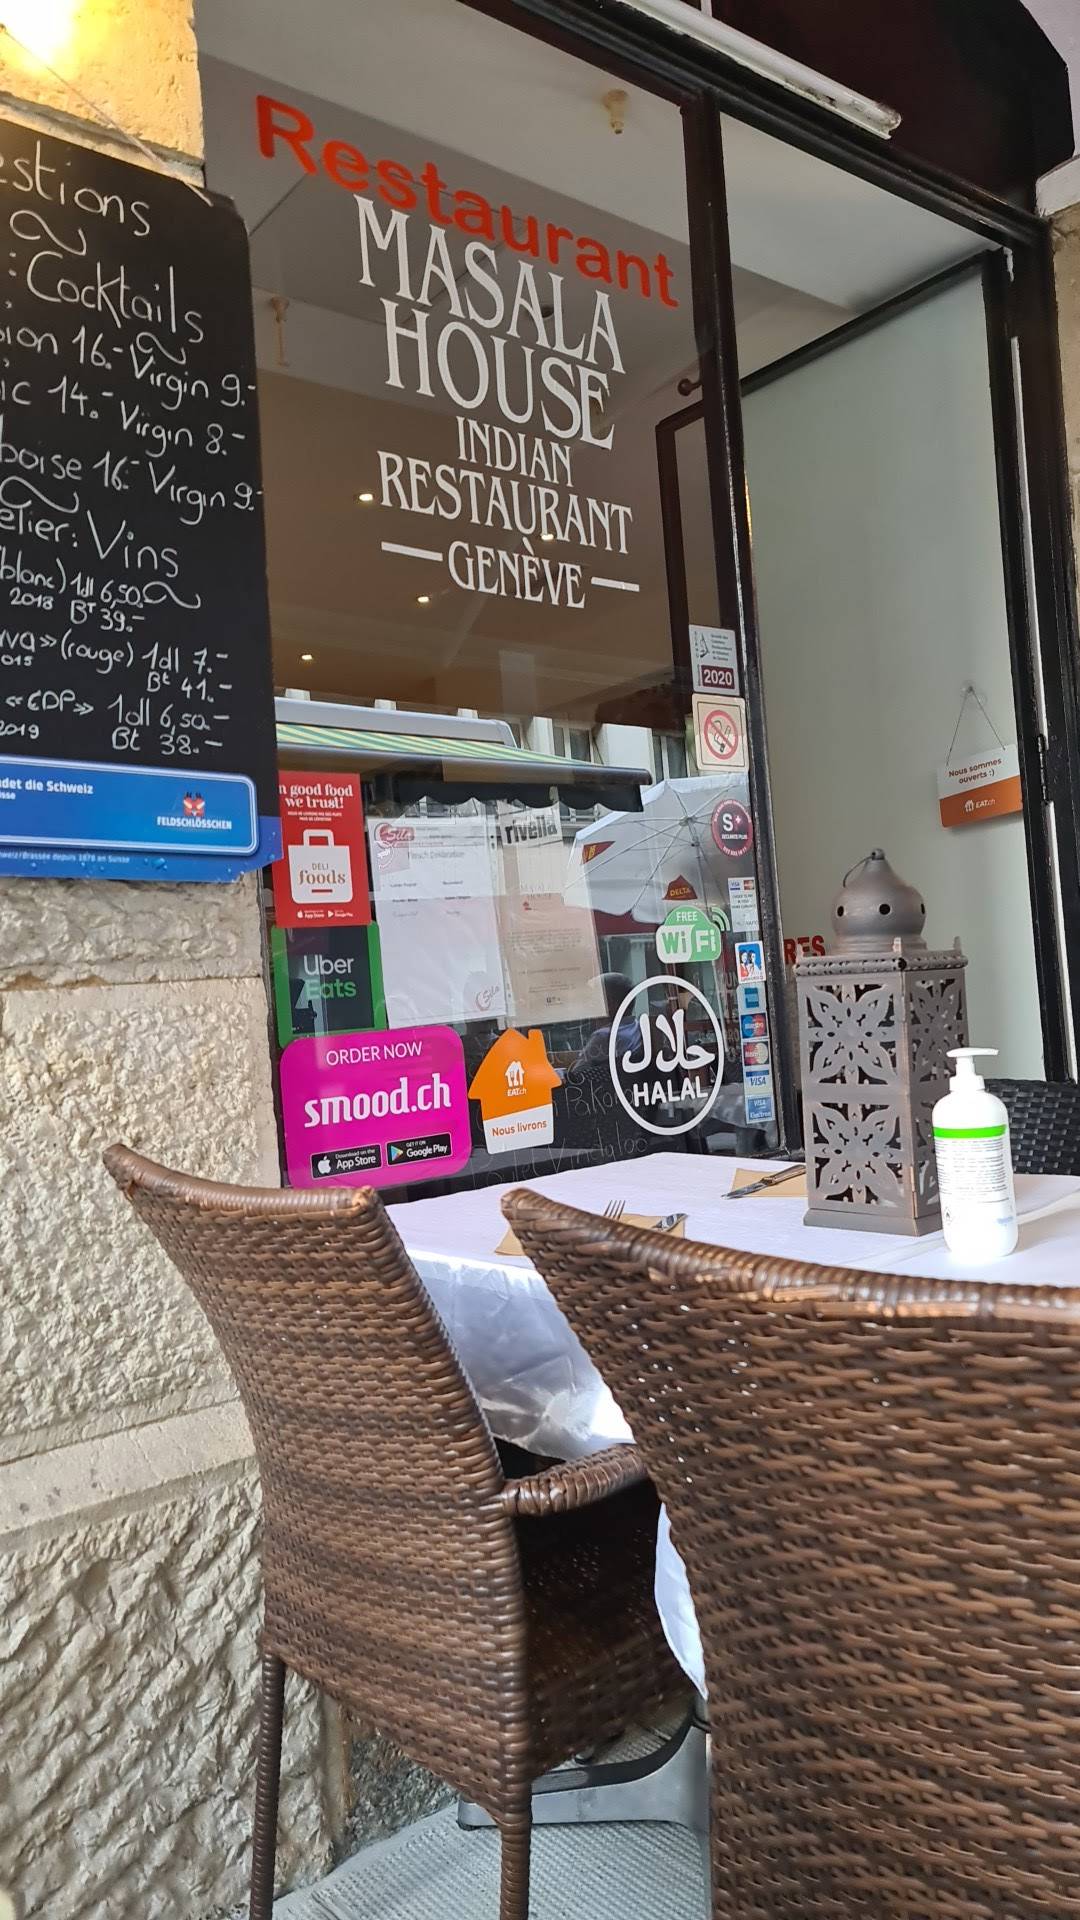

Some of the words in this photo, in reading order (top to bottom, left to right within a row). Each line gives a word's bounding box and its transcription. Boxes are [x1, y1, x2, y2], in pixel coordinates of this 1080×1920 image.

[256, 94, 680, 309] Restaurant
[353, 194, 626, 374] MASALA
[27, 251, 204, 343] Cocktails
[0, 302, 58, 355] ion
[130, 343, 209, 411] Virgin
[380, 298, 615, 451] HOUSE
[120, 400, 194, 458] Virgin
[455, 415, 574, 487] INDIAN
[148, 461, 226, 526] Virgin
[377, 450, 633, 554] RESTAURANT
[87, 510, 180, 578] Vins
[448, 536, 585, 609] GENÈVE
[9, 586, 54, 610] 2018
[61, 629, 134, 674] (rouge)
[142, 642, 179, 673] 1dl
[147, 671, 171, 692] Bt
[703, 668, 733, 686] 2020
[107, 694, 150, 726] 1dl
[112, 726, 140, 751] Bt
[949, 768, 968, 777] Nous
[969, 759, 1002, 772] sommes
[958, 772, 988, 784] ouverts
[25, 779, 44, 791] die
[46, 780, 94, 795] Schweiz
[290, 783, 322, 798] good
[325, 783, 353, 797] food
[285, 797, 304, 808] we
[306, 796, 344, 809] trust!
[157, 816, 232, 830] FELDSCHLÖSSCHEN
[505, 815, 558, 844] rivella
[299, 870, 346, 885] foods
[312, 862, 329, 870] DELI
[676, 911, 698, 922] FREE
[303, 954, 355, 975] Uber
[305, 978, 357, 999] Eats
[621, 1008, 716, 1073] حلال
[326, 1045, 380, 1066] ORDER
[384, 1041, 423, 1058] NOW
[632, 1076, 709, 1107] HALAL
[750, 1076, 767, 1086] VISA
[304, 1072, 452, 1128] smood.ch
[491, 1126, 516, 1137] Nous
[517, 1120, 548, 1133] livrons
[336, 1158, 354, 1171] App
[355, 1156, 377, 1166] Store
[406, 1147, 433, 1158] Google
[433, 1144, 448, 1154] Play
